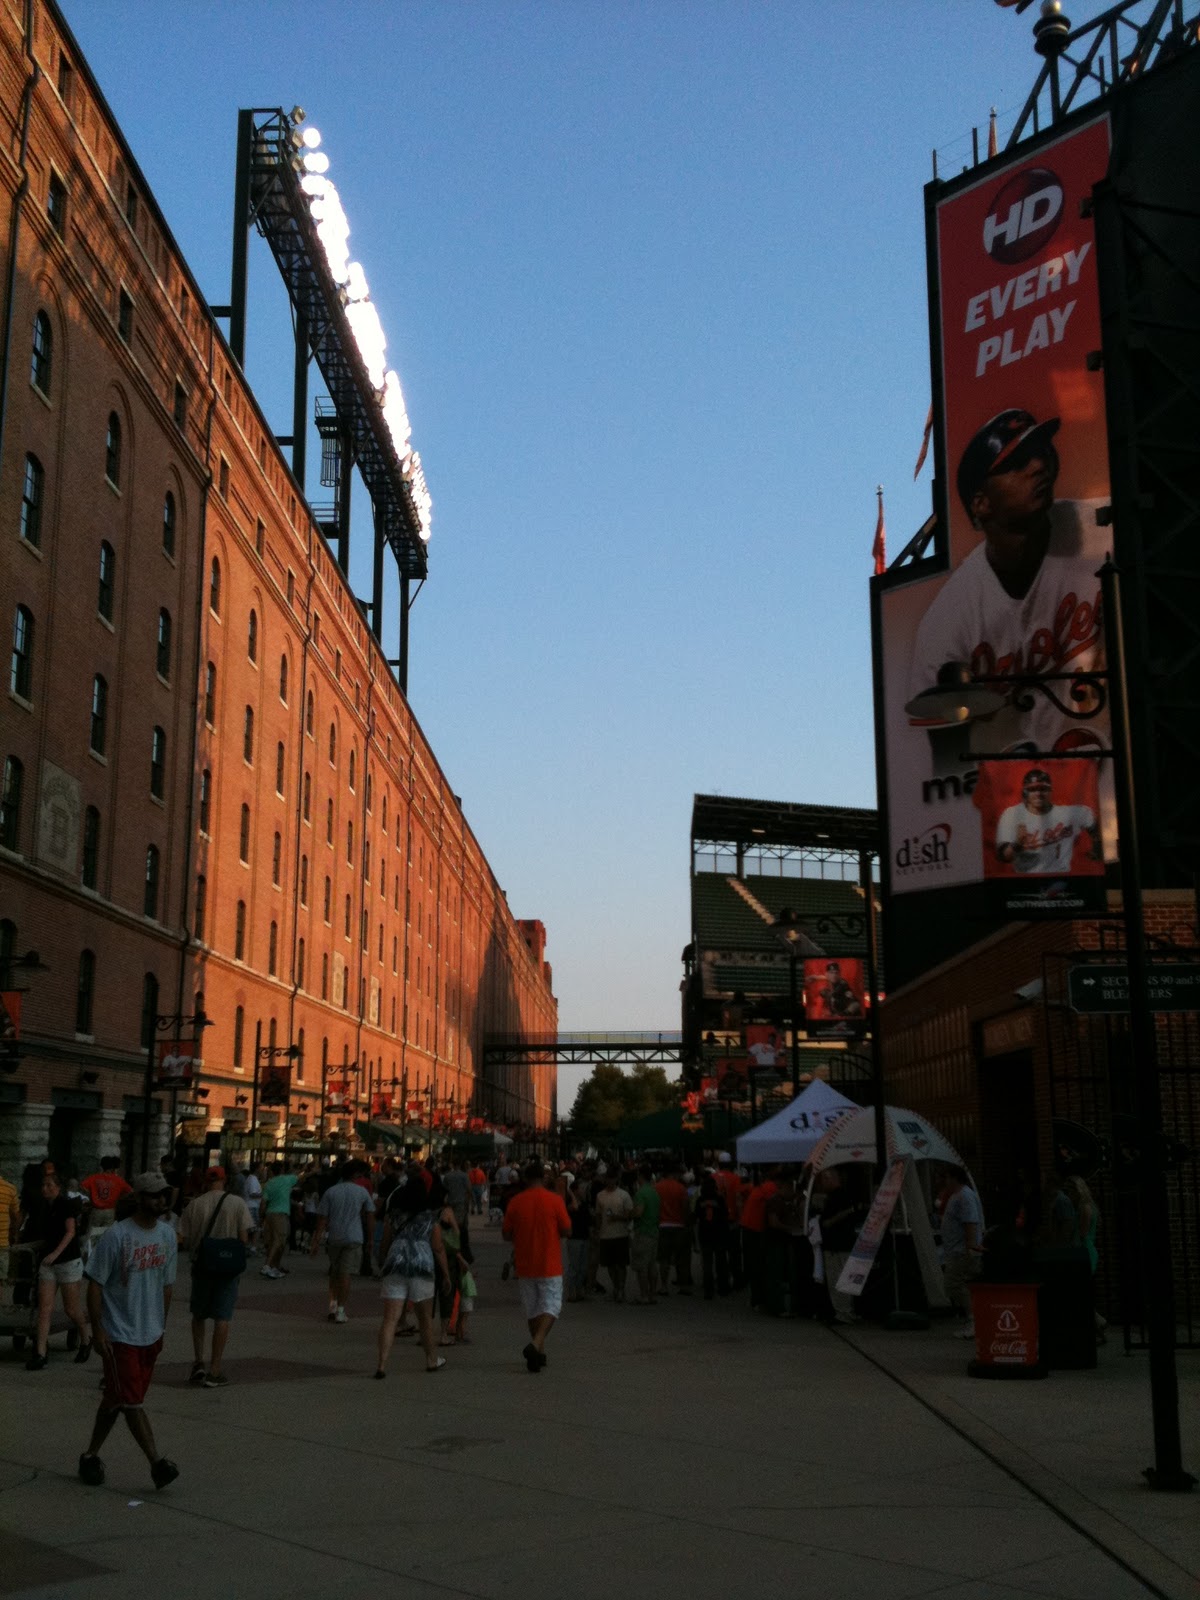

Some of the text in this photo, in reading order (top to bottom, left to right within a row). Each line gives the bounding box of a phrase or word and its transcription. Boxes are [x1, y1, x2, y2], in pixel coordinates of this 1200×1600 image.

[983, 185, 1064, 254] HD
[965, 241, 1092, 333] EVERY
[976, 300, 1077, 377] PLAY
[896, 833, 951, 868] dish
[1161, 975, 1174, 985] 90
[1175, 975, 1194, 985] and
